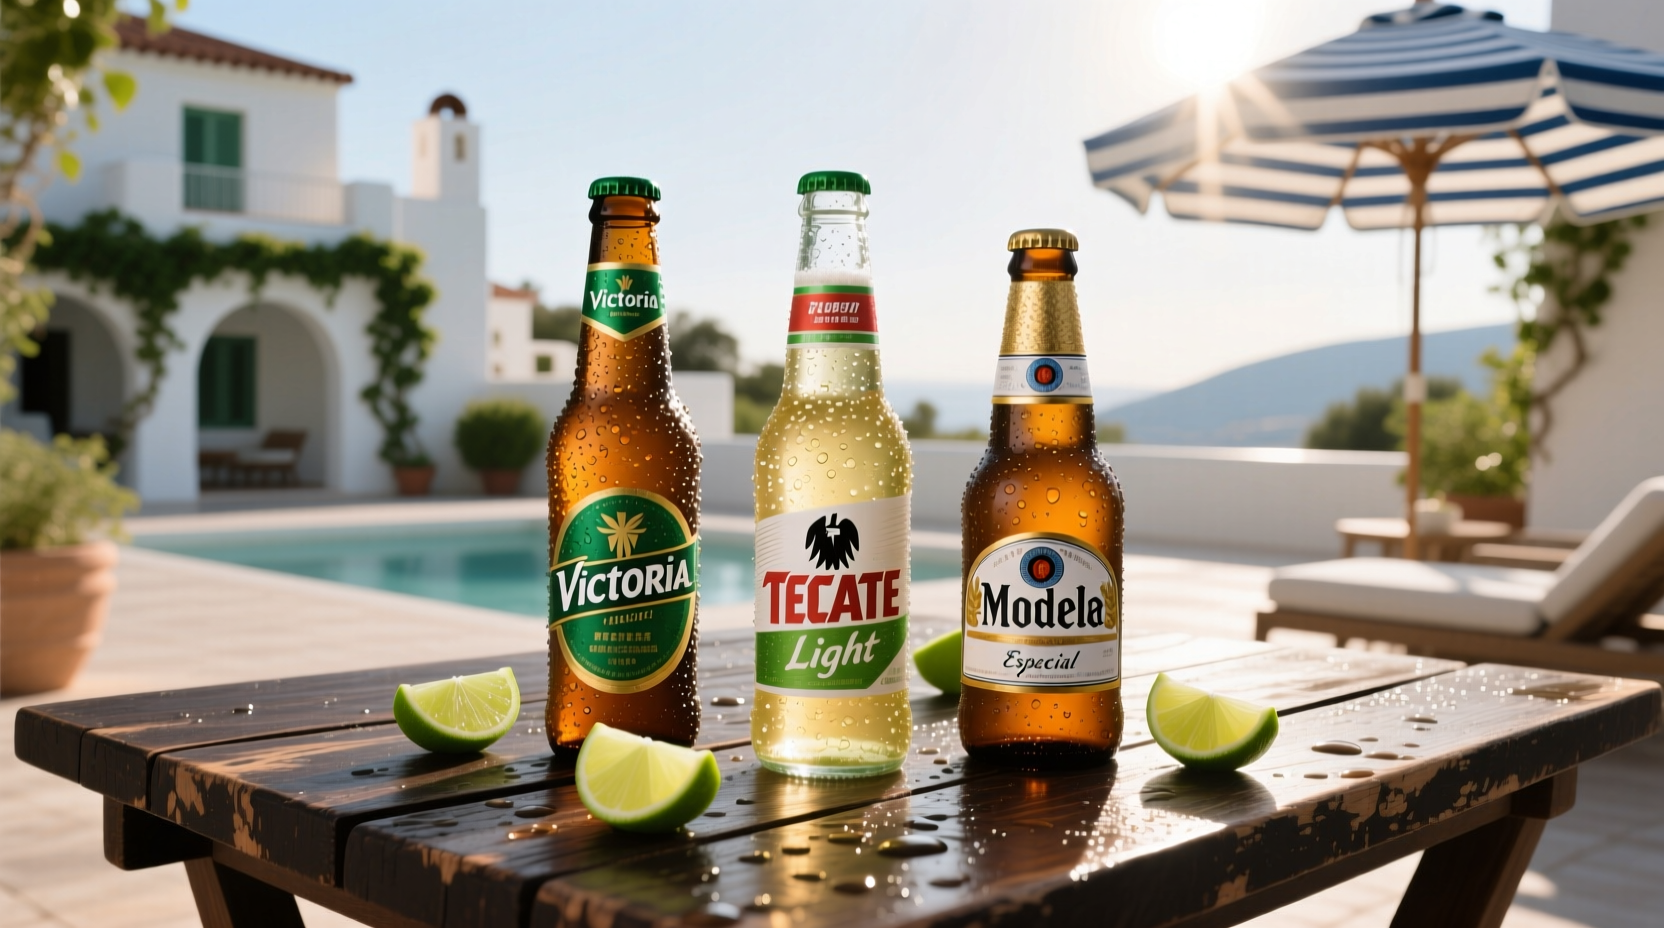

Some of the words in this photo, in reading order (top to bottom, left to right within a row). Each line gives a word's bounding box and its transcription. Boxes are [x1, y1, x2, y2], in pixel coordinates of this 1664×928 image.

[590, 289, 659, 311] Victoria
[762, 569, 901, 625] TECATE
[981, 582, 1104, 630] Modela
[785, 630, 881, 679] Light
[1003, 650, 1081, 678] Especial
